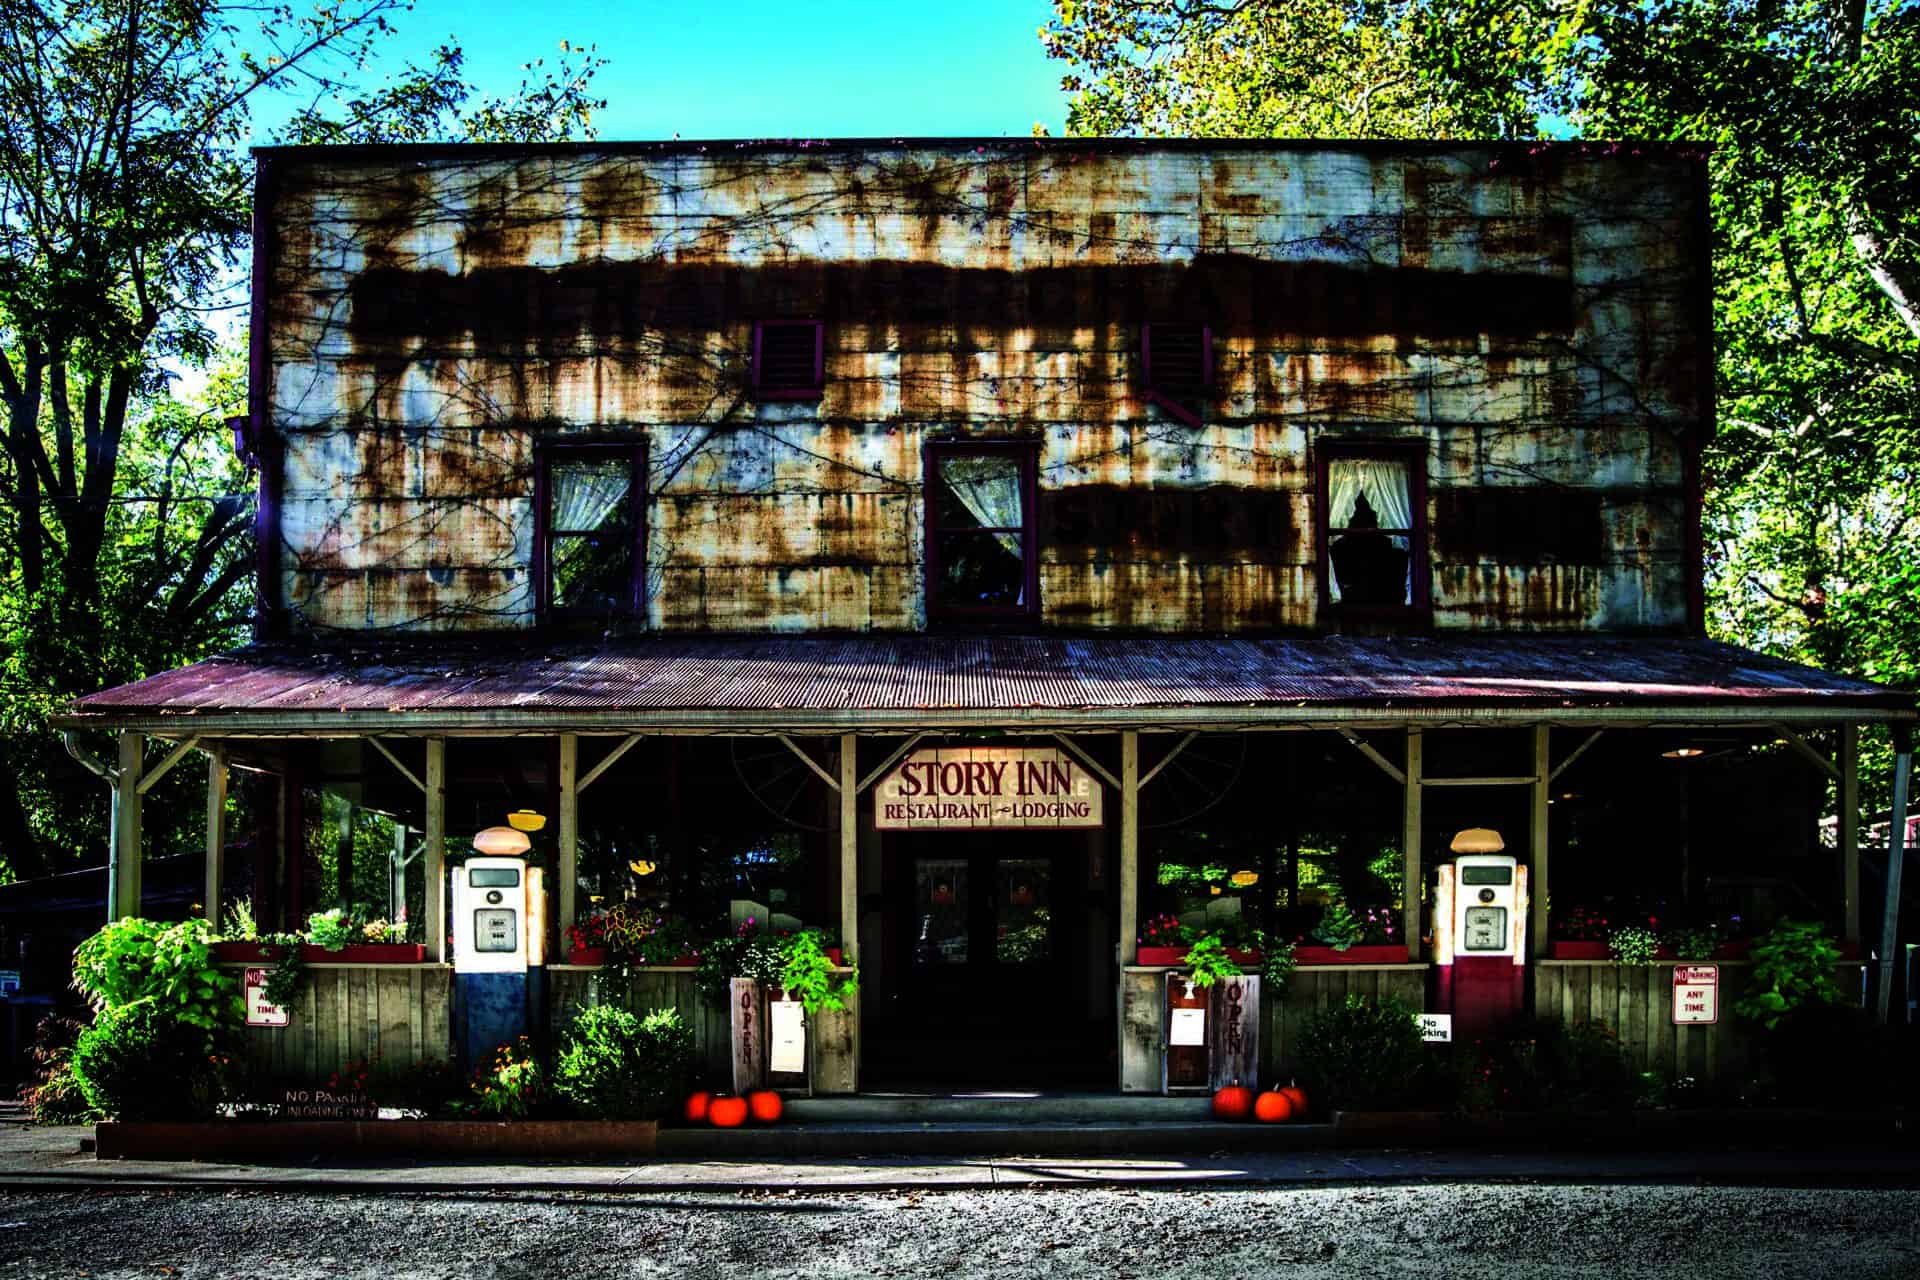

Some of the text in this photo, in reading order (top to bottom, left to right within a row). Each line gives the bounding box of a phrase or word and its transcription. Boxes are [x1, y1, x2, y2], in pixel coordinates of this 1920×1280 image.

[898, 761, 1008, 796] STORY
[1016, 760, 1073, 796] INN
[885, 802, 1090, 819] RESTAURANT LODGING
[247, 970, 259, 984] NO
[1675, 969, 1688, 982] NO
[1686, 991, 1704, 999] ANY
[257, 1006, 277, 1014] TIME
[1685, 1003, 1705, 1012] TIME
[1227, 982, 1242, 1055] OPEN
[1423, 1014, 1437, 1027] No
[741, 991, 752, 1065] OPEN
[286, 1090, 309, 1102] NO
